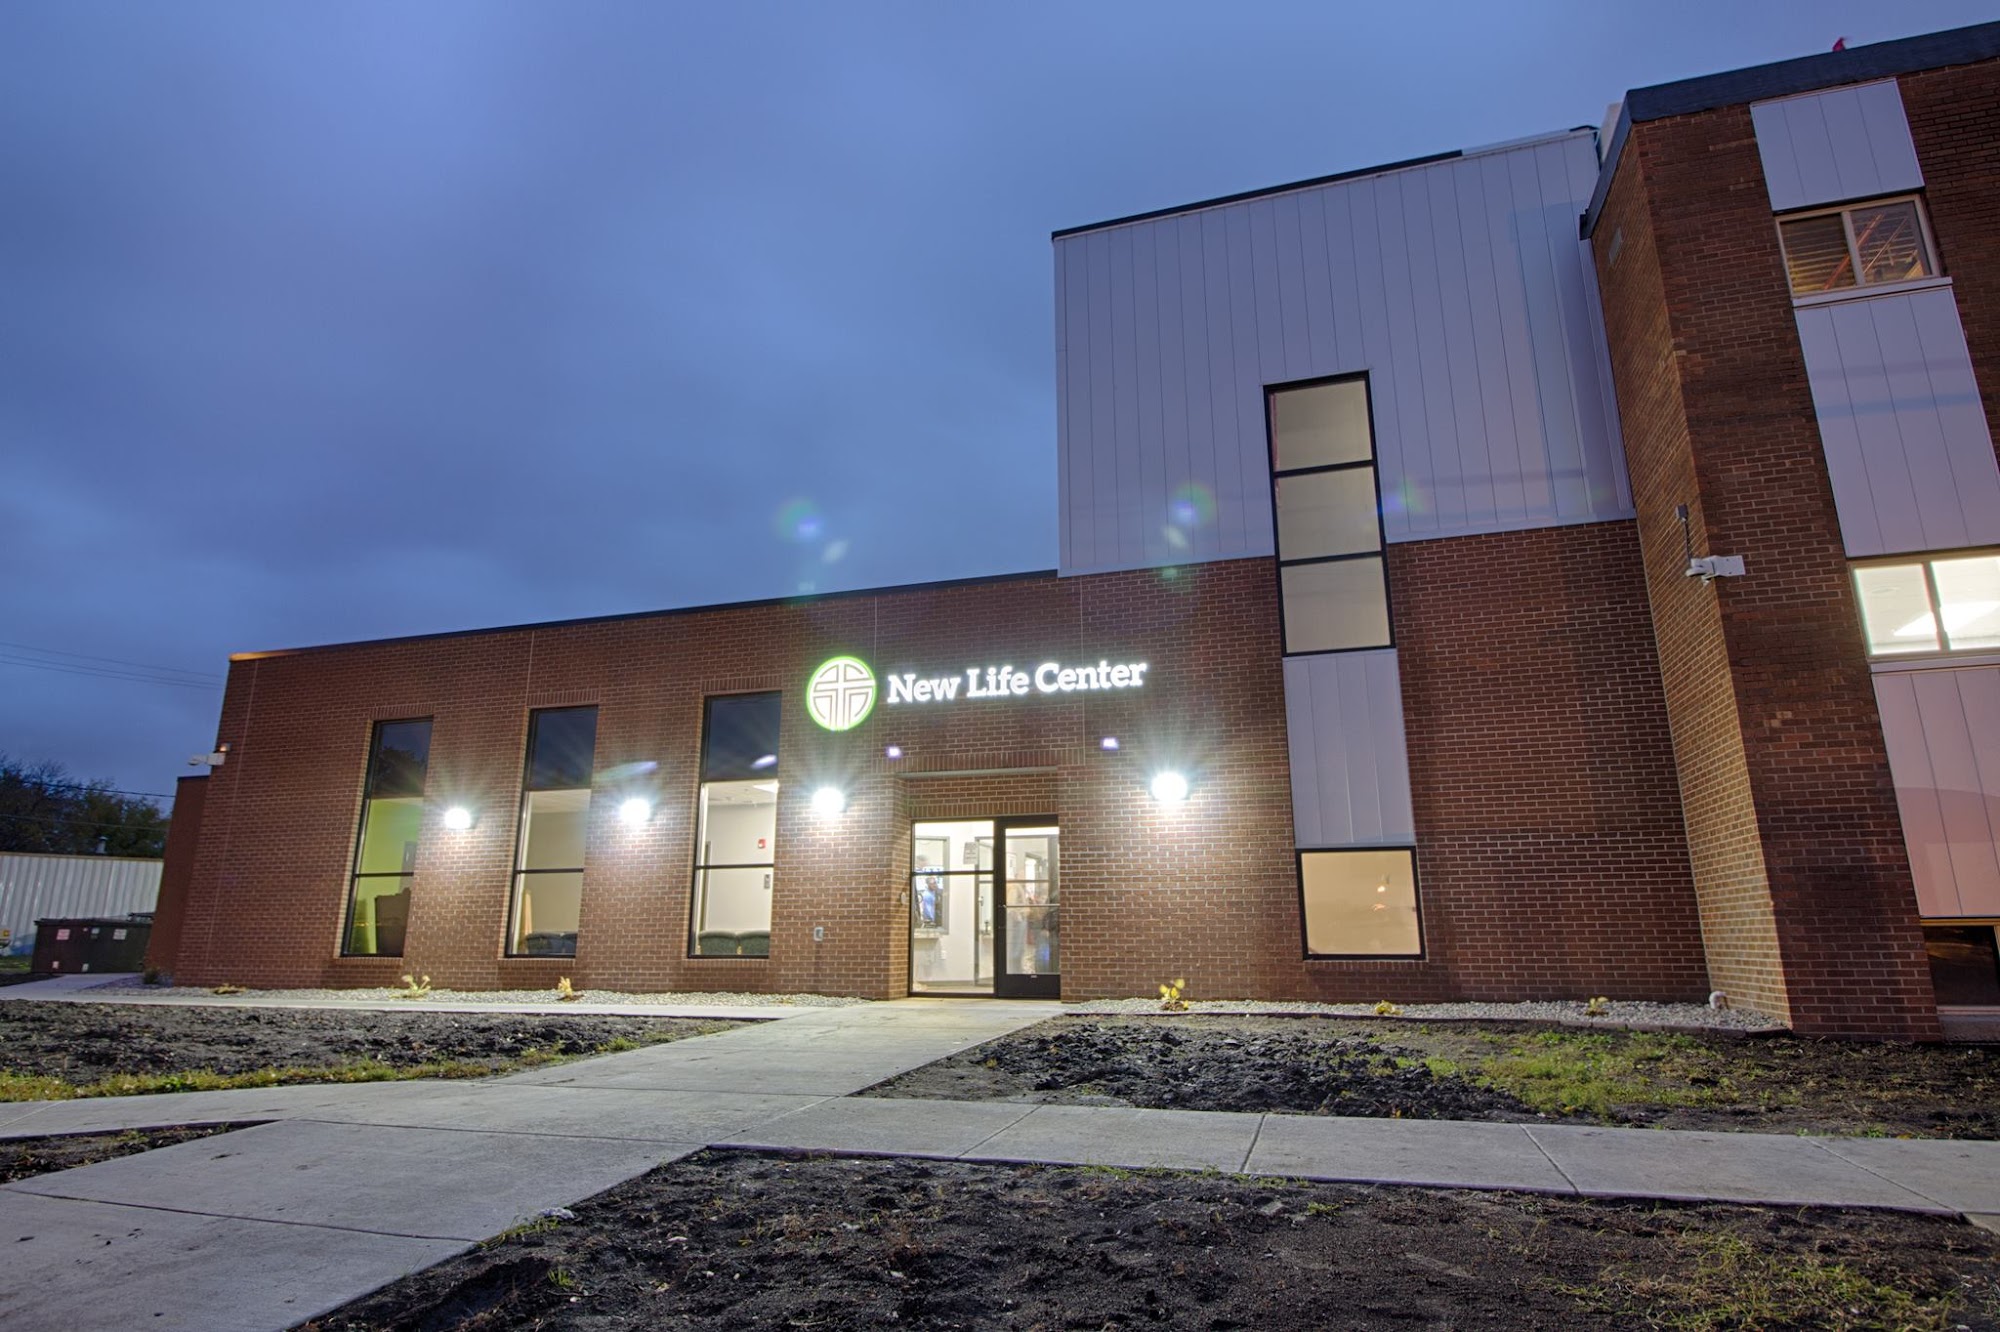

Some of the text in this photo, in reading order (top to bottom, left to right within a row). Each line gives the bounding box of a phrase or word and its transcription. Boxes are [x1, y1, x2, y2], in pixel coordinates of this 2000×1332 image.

[887, 661, 1147, 703] New Life Center
